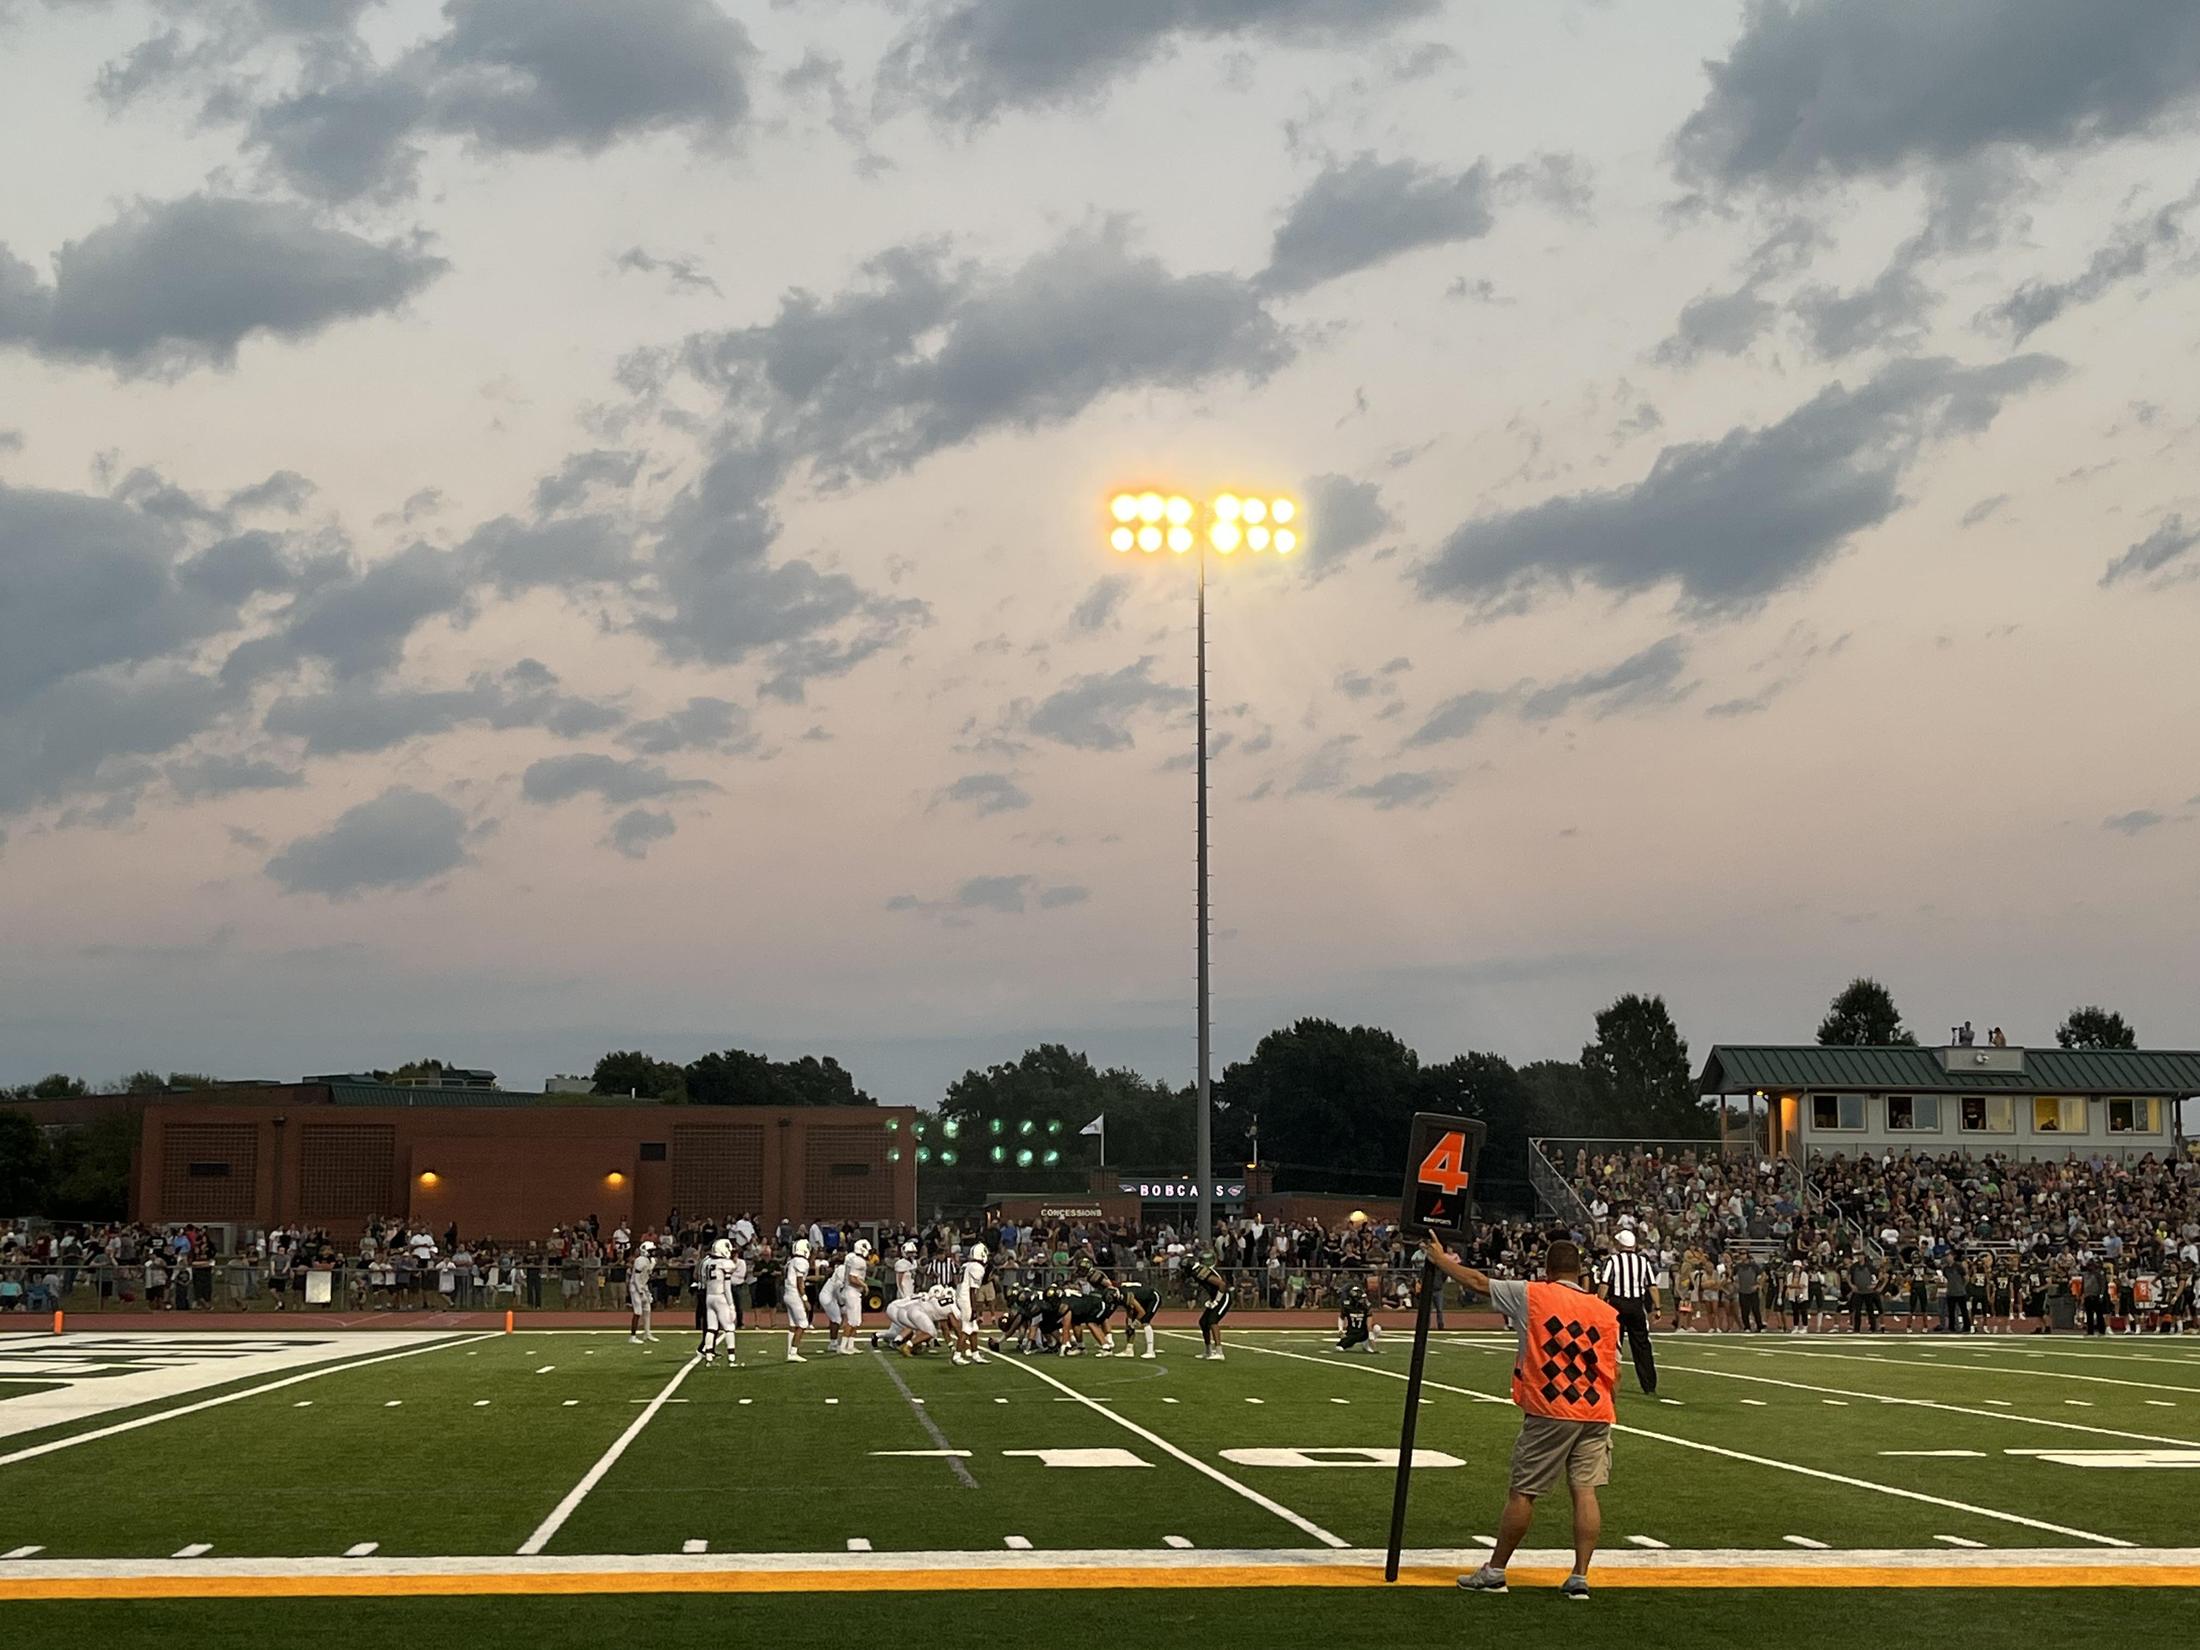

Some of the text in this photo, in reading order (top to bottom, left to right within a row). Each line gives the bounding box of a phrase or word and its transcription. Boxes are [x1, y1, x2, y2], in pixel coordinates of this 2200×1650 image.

[1418, 1131, 1469, 1195] 4
[1140, 1185, 1224, 1197] BOBCAS
[1040, 1209, 1102, 1217] CONCESSIONS
